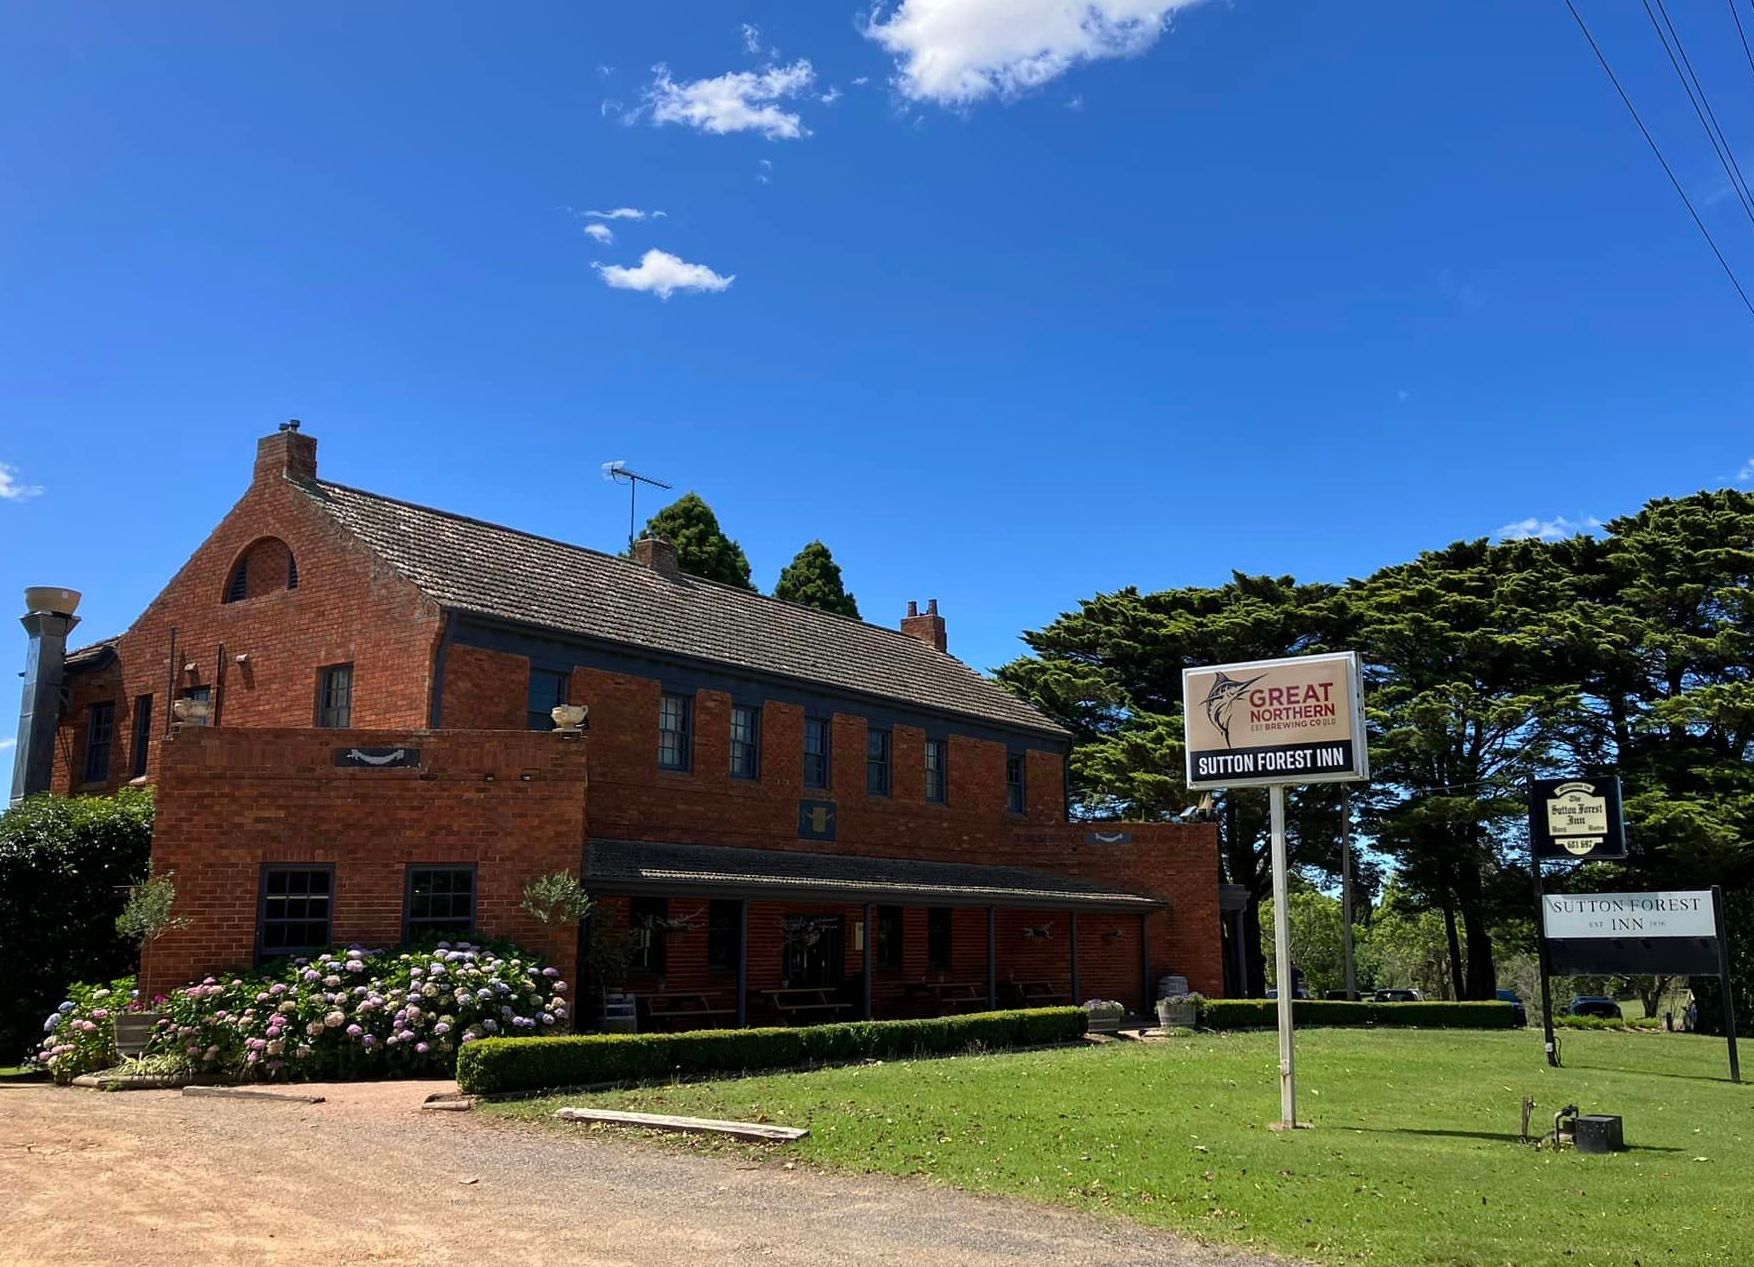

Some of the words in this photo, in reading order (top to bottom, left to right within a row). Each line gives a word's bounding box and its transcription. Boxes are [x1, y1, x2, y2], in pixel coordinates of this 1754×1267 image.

[1250, 682, 1333, 708] GREAT
[1250, 703, 1335, 723] NORTHERN
[1265, 720, 1308, 731] BREWING
[1199, 754, 1253, 775] SUTTON
[1258, 749, 1312, 771] FOREST
[1317, 747, 1344, 767] INN
[1551, 804, 1577, 815] Sutton
[1577, 803, 1603, 814] Forest
[1552, 899, 1624, 914] SUTTON
[1630, 898, 1701, 912] FOREST
[1611, 917, 1644, 931] INN
